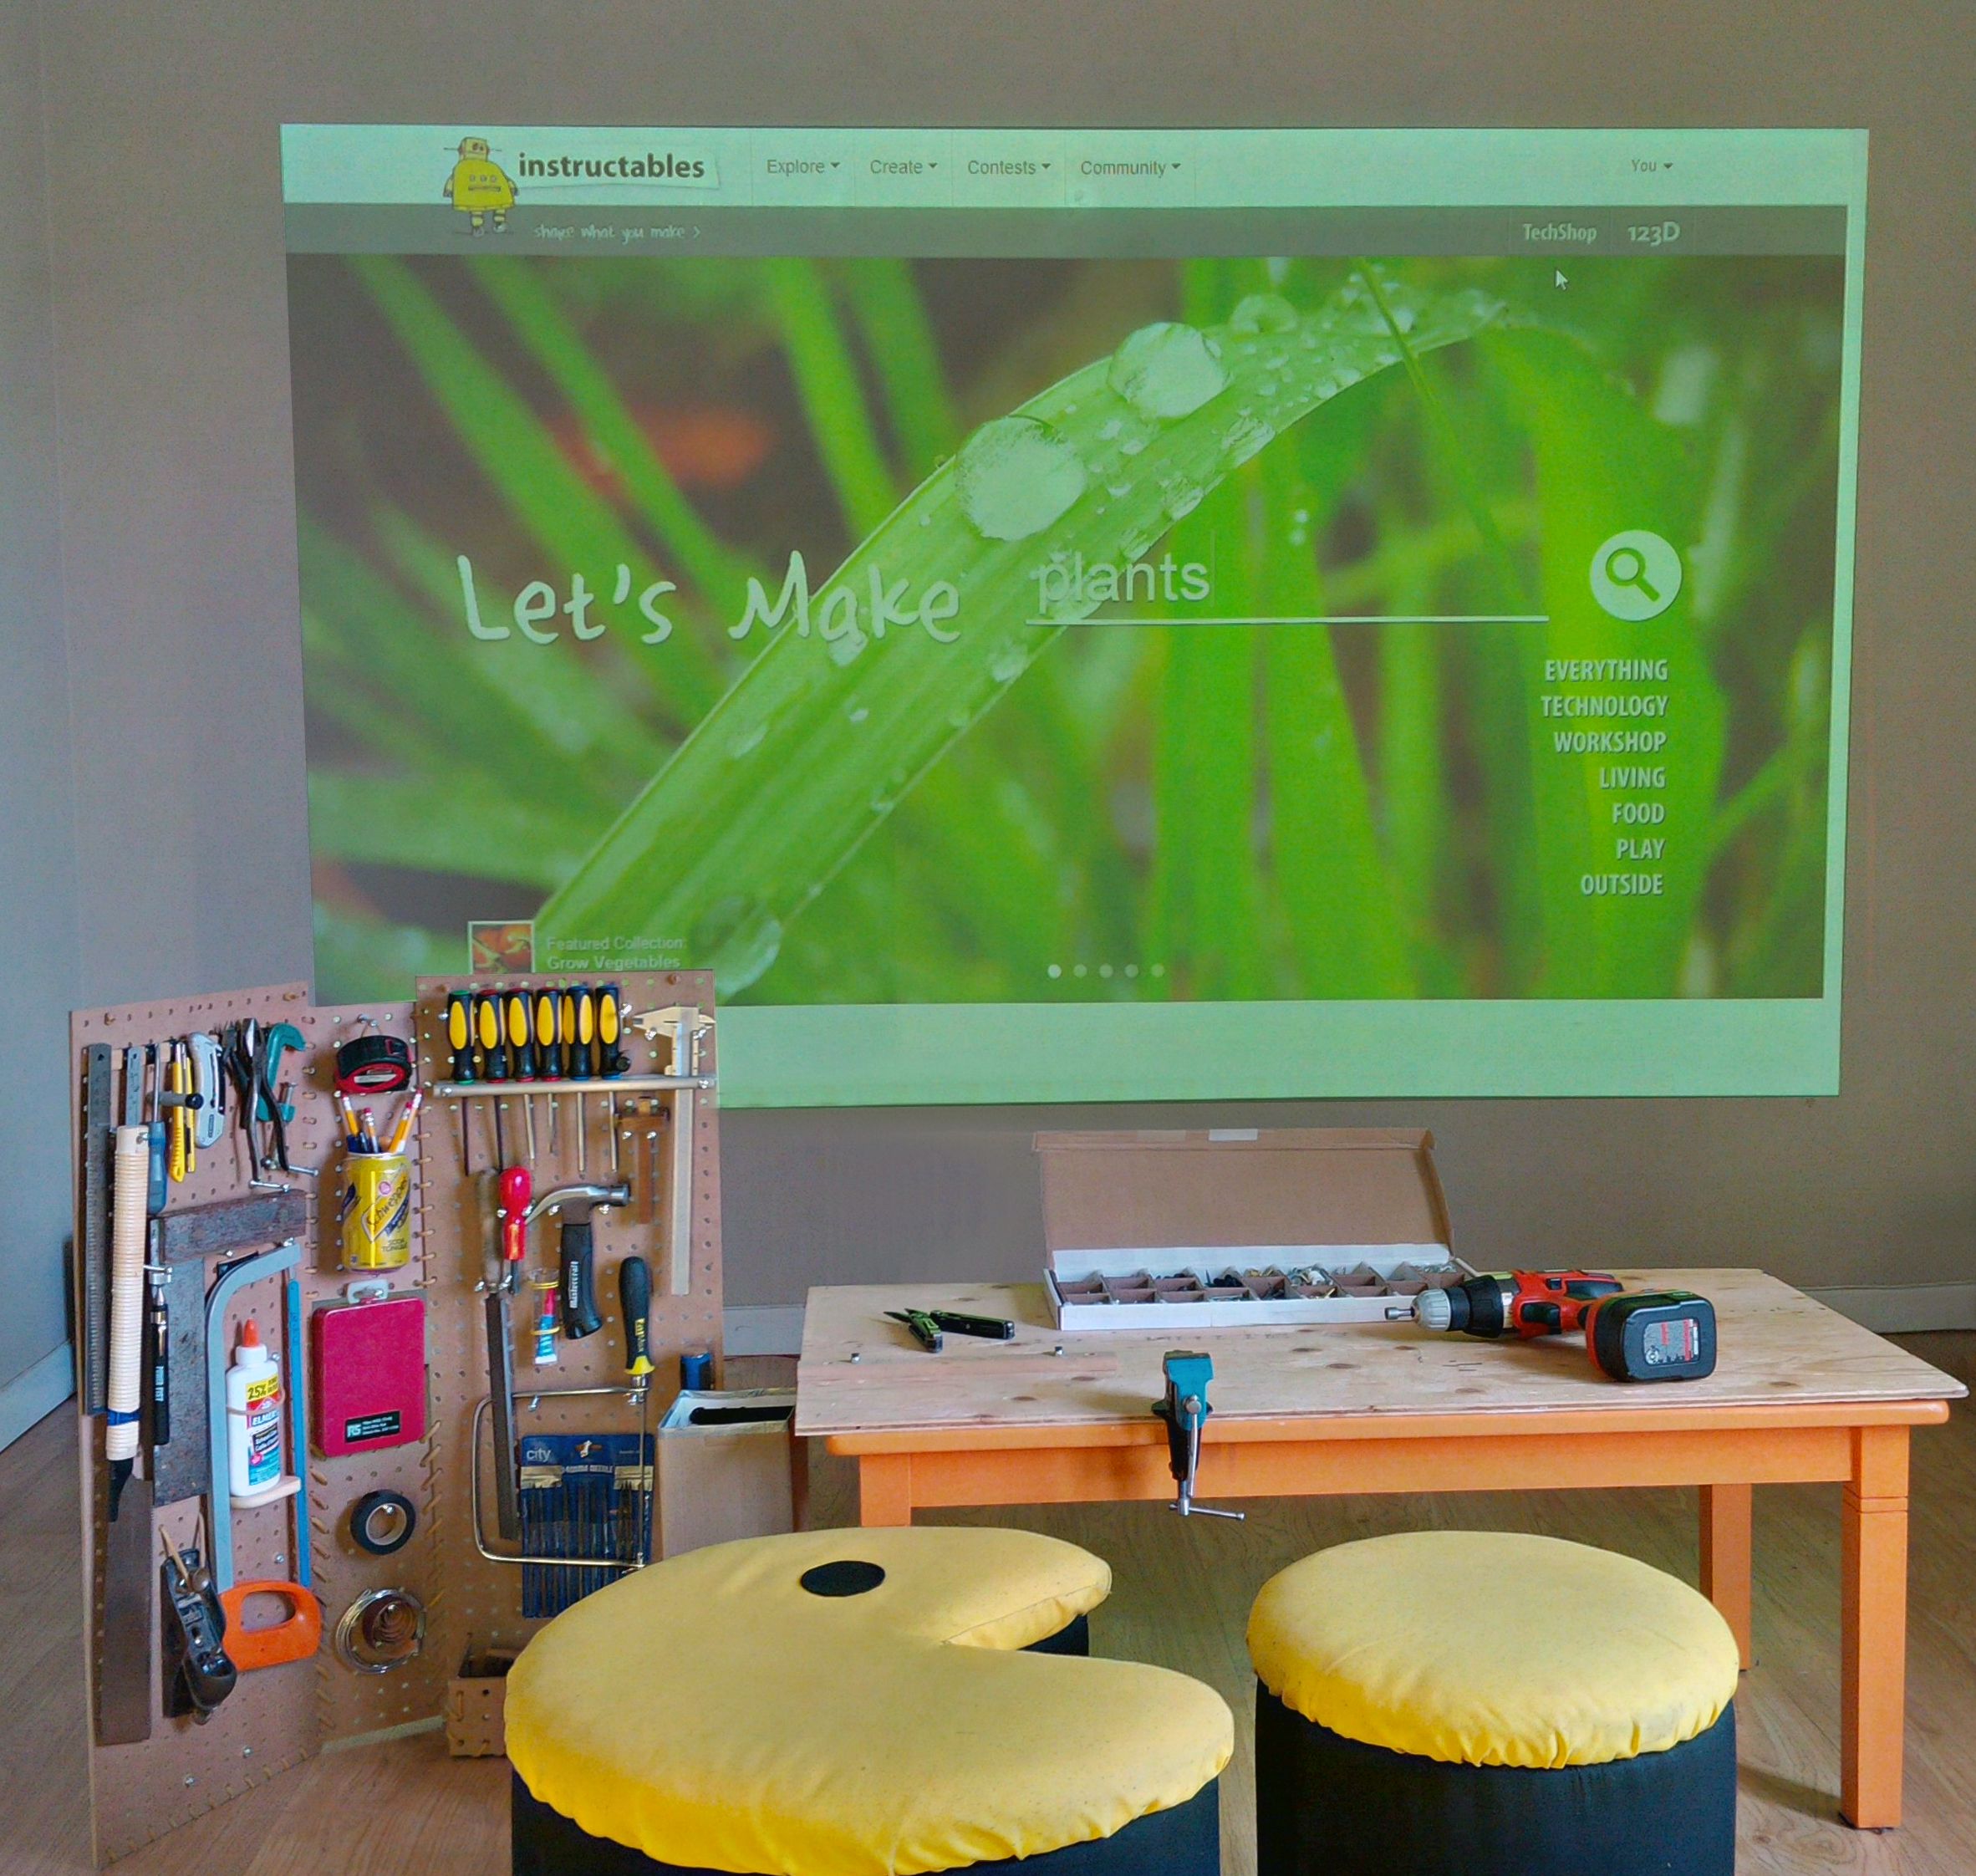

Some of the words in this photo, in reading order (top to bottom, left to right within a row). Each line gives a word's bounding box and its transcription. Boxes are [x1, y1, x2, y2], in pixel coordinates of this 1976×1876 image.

[518, 152, 705, 179] instructables
[766, 159, 826, 177] Explore
[869, 159, 923, 176] Create
[967, 159, 1036, 176] Contests
[1081, 160, 1167, 179] Community
[1632, 159, 1657, 172] You
[580, 224, 615, 240] what
[621, 227, 644, 245] you
[649, 225, 685, 239] make
[1522, 222, 1597, 246] TechShop
[1627, 221, 1681, 247] 123D
[1036, 551, 1210, 615] plants
[457, 554, 676, 645] Let's
[728, 549, 961, 644] Make
[1544, 658, 1669, 682] EVERYTHING
[1541, 695, 1668, 718] TECHNOLOGY
[1553, 731, 1668, 753] WORKSHOP
[1598, 766, 1667, 789] LIVING
[1612, 802, 1666, 824] FOOD
[1616, 838, 1666, 860] PLAY
[1580, 874, 1664, 896] OUTSIDE
[547, 936, 610, 951] Featured
[548, 956, 588, 970] Grow
[594, 954, 681, 971] Vegetables
[526, 1448, 553, 1462] city
